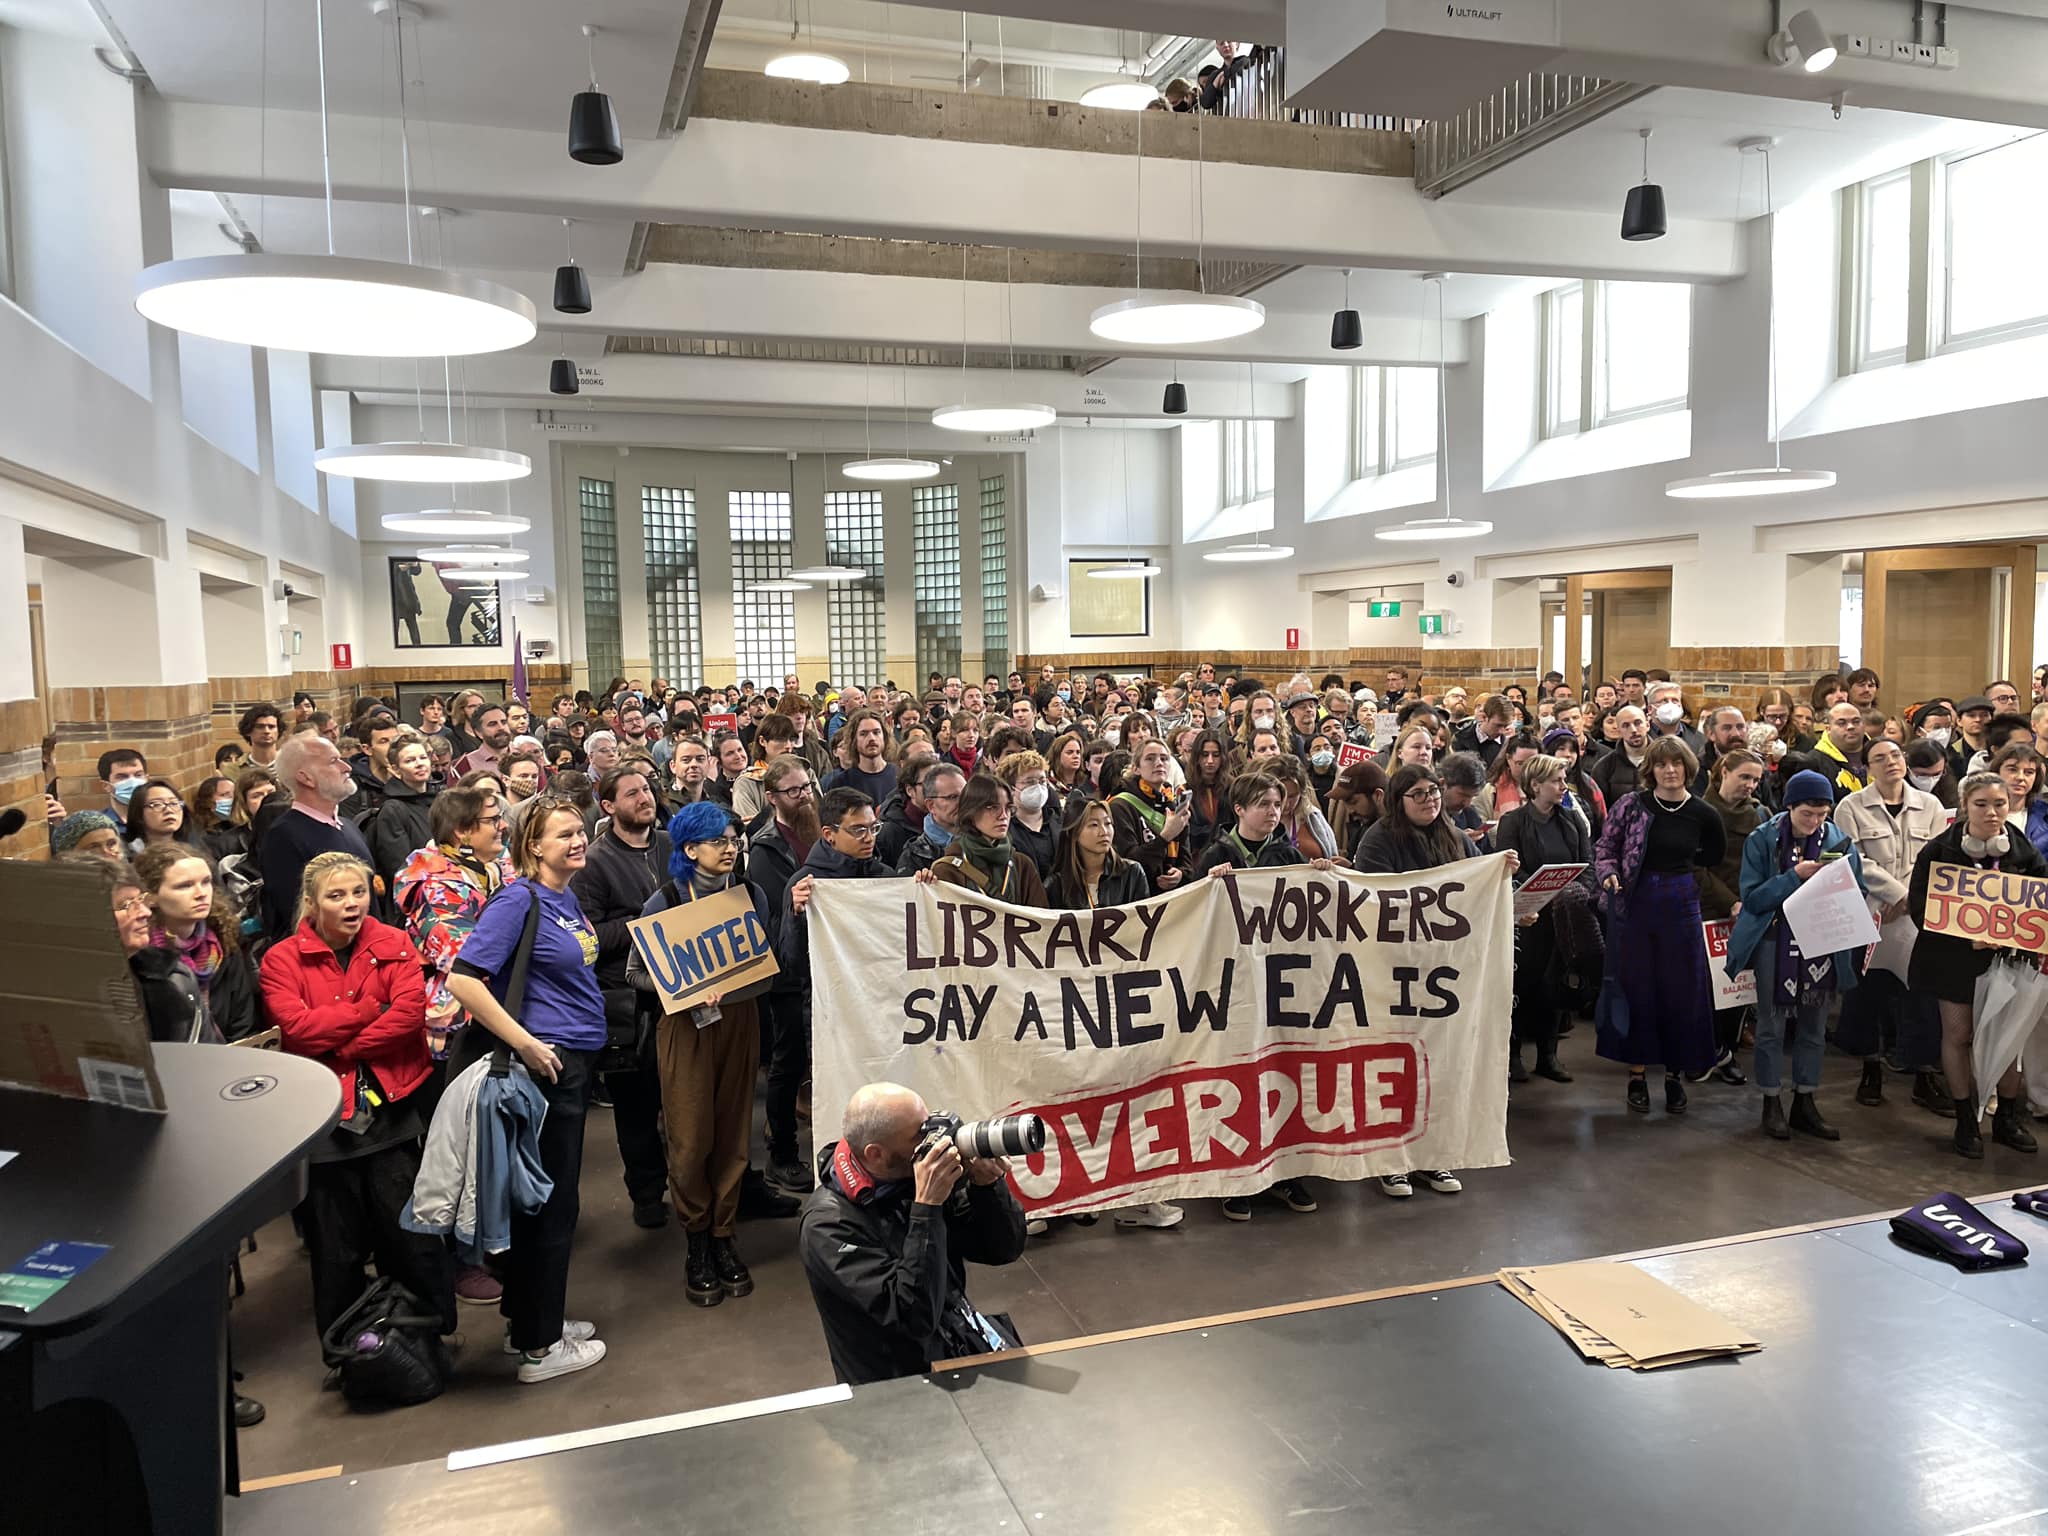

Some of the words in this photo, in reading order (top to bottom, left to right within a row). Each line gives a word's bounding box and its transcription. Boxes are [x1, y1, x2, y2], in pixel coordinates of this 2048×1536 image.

[1456, 7, 1503, 20] ULTRALIFT
[709, 719, 729, 727] Union
[1346, 747, 1361, 759] I'M
[1528, 880, 1566, 889] STRIKE
[1557, 869, 1577, 879] ON
[1934, 866, 2048, 909] SECUR
[905, 901, 1168, 971] LIBRARY
[1222, 874, 1471, 945] WORKERS
[1711, 925, 1730, 939] I'M
[1925, 893, 2048, 950] JOBS
[634, 910, 769, 994] UNITED
[1722, 982, 1757, 995] BALANCE
[903, 984, 998, 1045] SAY
[1014, 991, 1048, 1042] A
[1060, 957, 1235, 1051] NEW
[1265, 953, 1369, 1029] EA
[1389, 965, 1460, 1018] IS
[1009, 1057, 1405, 1200] OVERDUE
[836, 1152, 857, 1189] Canon
